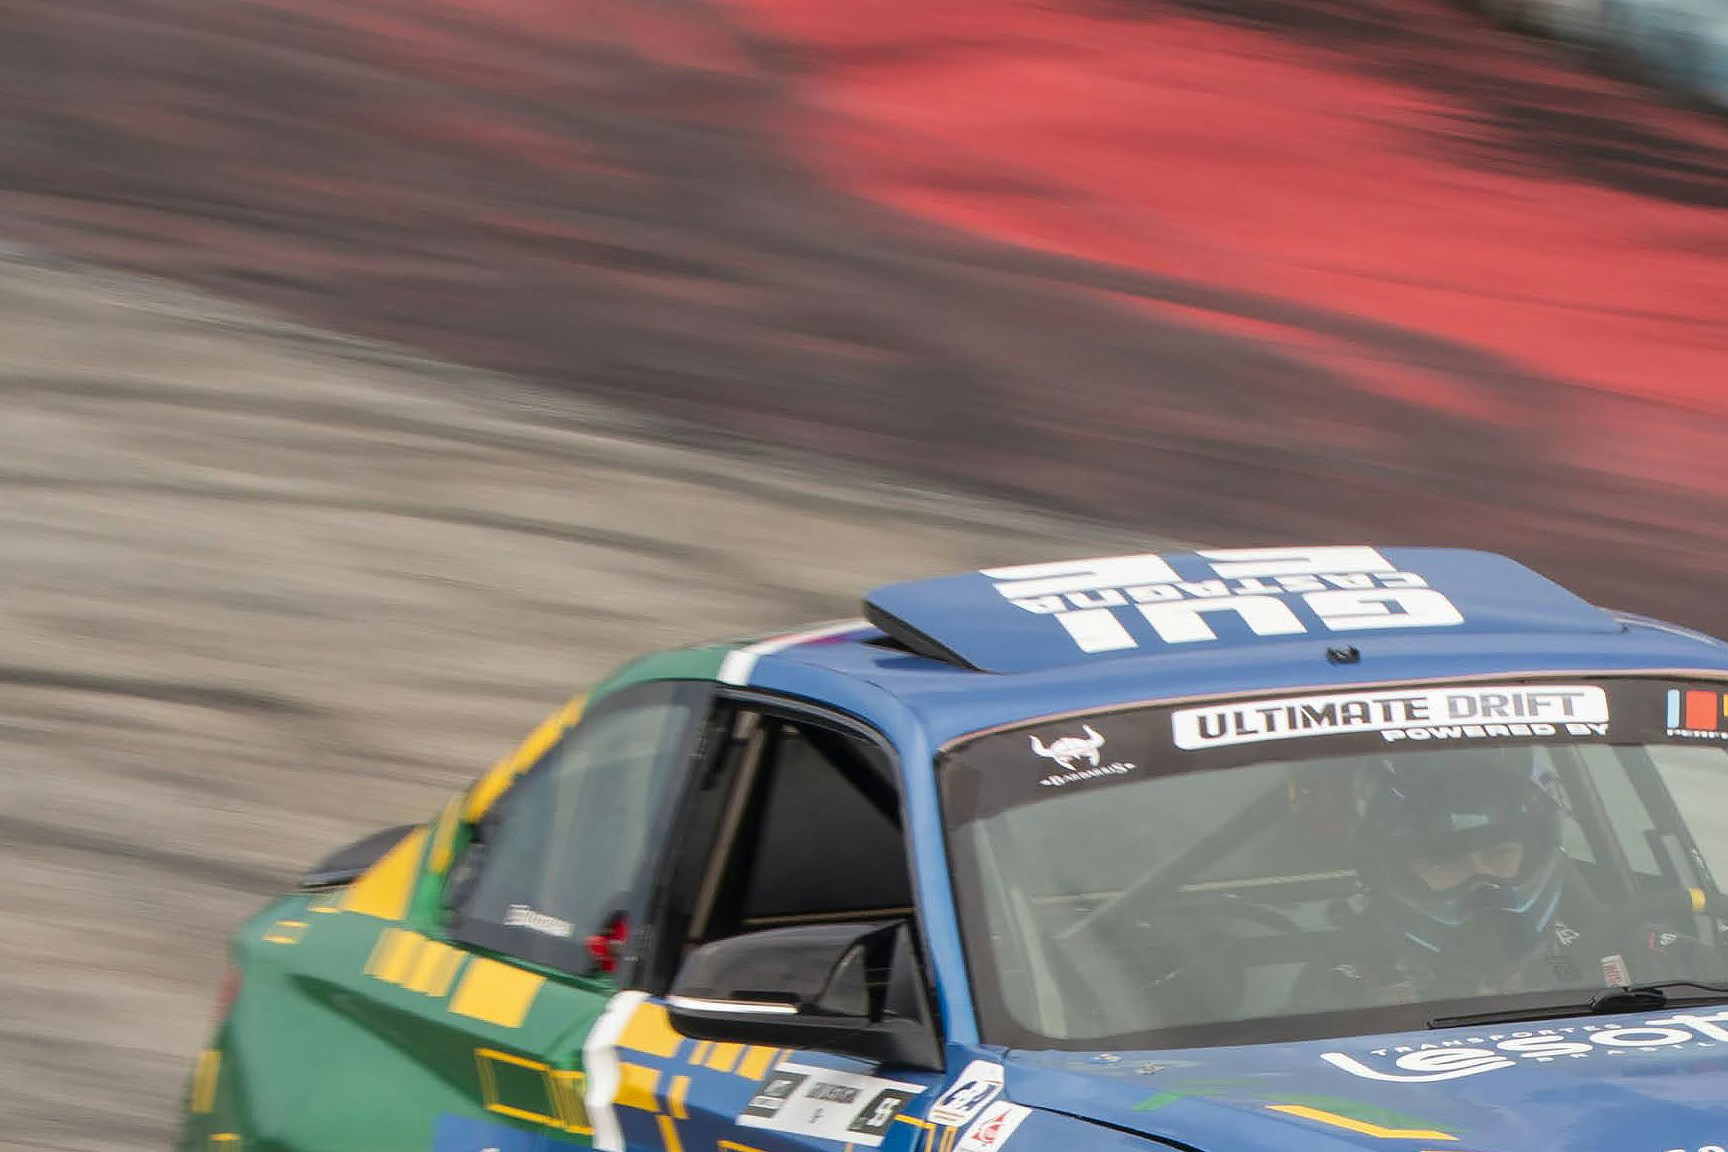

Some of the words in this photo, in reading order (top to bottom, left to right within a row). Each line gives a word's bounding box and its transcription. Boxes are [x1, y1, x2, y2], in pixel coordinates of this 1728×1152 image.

[1197, 696, 1430, 739] ULTIMATE
[1446, 691, 1585, 719] DRIFT
[1380, 722, 1557, 742] POWERED
[1564, 722, 1608, 736] BY
[1369, 1022, 1624, 1057] TRANSPORTES
